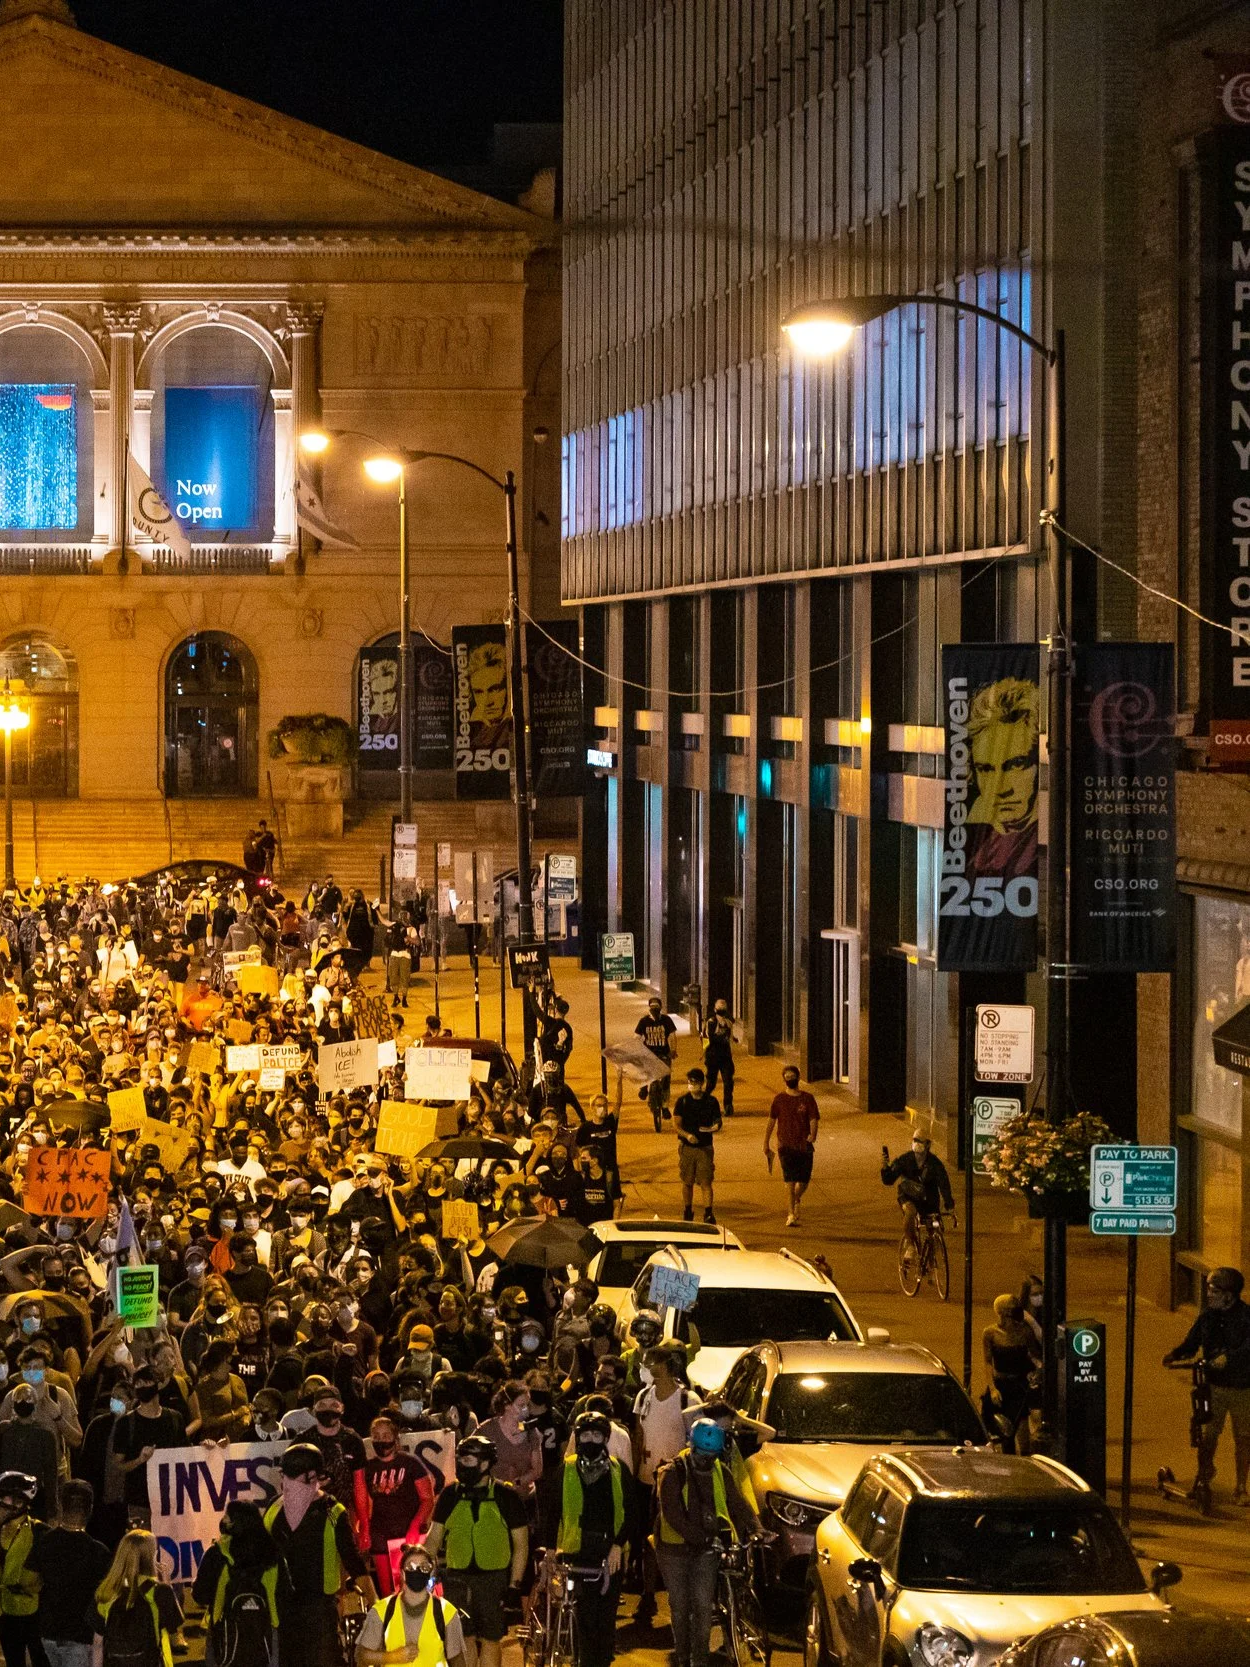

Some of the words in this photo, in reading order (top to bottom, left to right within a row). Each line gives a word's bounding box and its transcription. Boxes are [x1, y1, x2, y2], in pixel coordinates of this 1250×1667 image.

[177, 480, 217, 496] Now
[177, 502, 223, 523] Open
[133, 516, 170, 543] OUNTY
[359, 659, 370, 734] Beethoven
[456, 643, 470, 749] Beethoven
[359, 734, 399, 750] 250
[456, 749, 510, 771] 250
[942, 677, 968, 874] Beethoven
[1084, 776, 1168, 788] CHICAGO
[1084, 789, 1168, 801] SYMPHONY
[1084, 803, 1168, 815] ORCHESTRA
[1085, 829, 1168, 840] RICCARDO
[1109, 843, 1144, 854] MUTI
[1094, 878, 1159, 890] CSO.ORG
[939, 876, 1038, 917] 250
[262, 1047, 300, 1057] DEFUND
[263, 1058, 302, 1069] POLICE
[335, 1059, 355, 1071] ICE!
[1003, 1073, 1027, 1081] ZONE
[382, 1103, 433, 1127] GOOD
[1100, 1150, 1120, 1159] PAY
[1123, 1150, 1138, 1159] TO
[1140, 1151, 1170, 1160] PARK
[42, 1192, 99, 1213] NOW
[1135, 1196, 1151, 1205] 513
[1096, 1219, 1101, 1228] 7
[1103, 1219, 1117, 1228] DAY
[1119, 1219, 1137, 1228] PAID
[124, 1296, 153, 1306] DEFUND
[238, 1364, 256, 1375] THE
[159, 1455, 276, 1516] INVES
